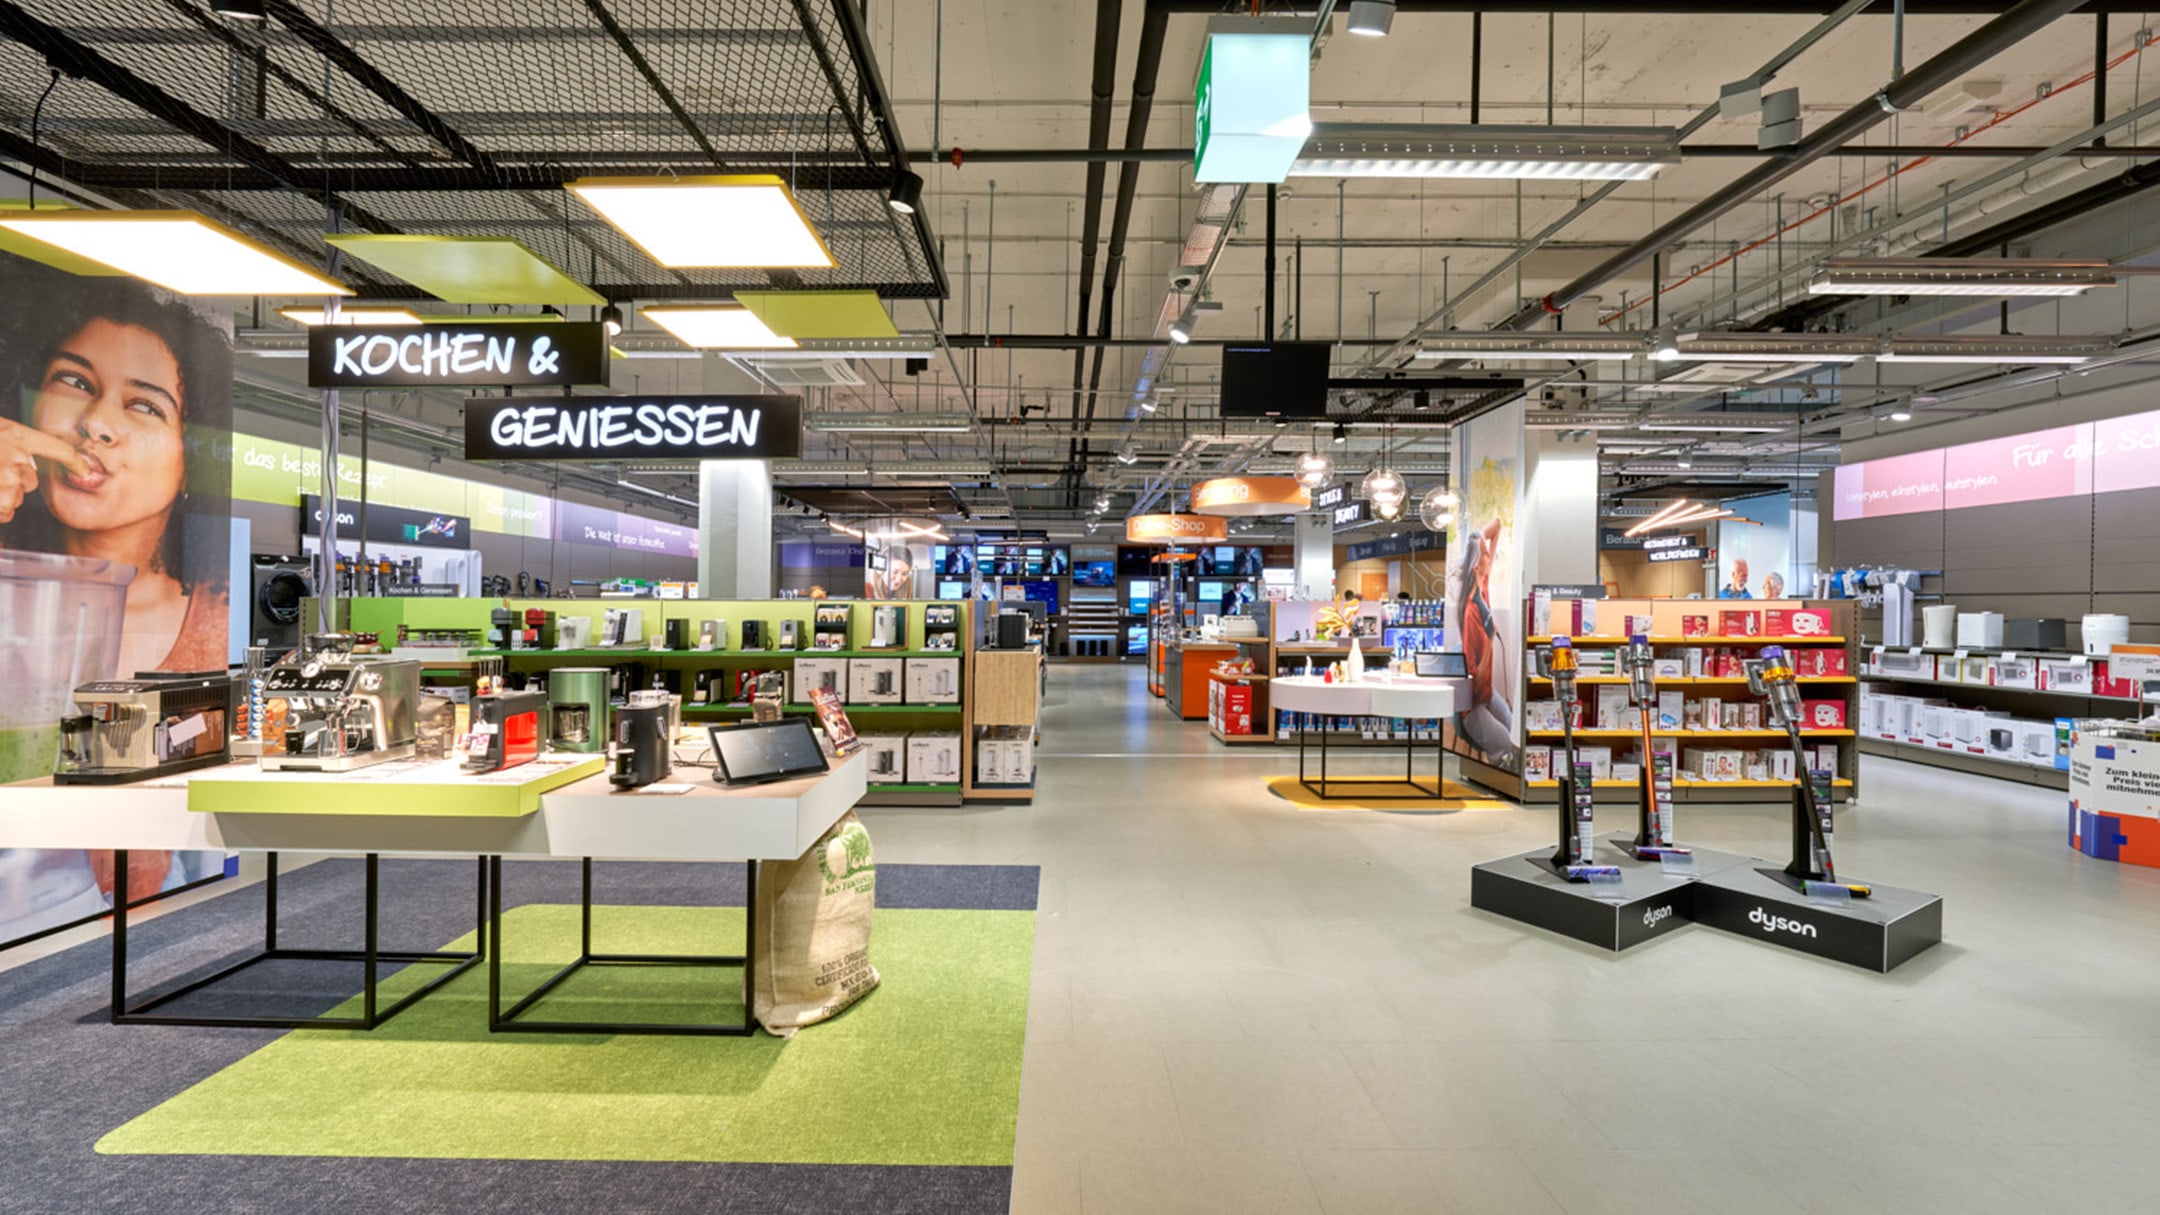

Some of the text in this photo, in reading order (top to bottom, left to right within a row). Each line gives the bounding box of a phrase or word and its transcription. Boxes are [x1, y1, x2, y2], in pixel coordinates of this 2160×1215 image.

[333, 332, 559, 377] KOCHEN &
[491, 405, 760, 448] GENIESSEN
[244, 447, 275, 471] das
[2012, 440, 2054, 468] Für
[2063, 438, 2108, 461] alle
[2105, 766, 2129, 776] Zum
[2112, 776, 2141, 787] Preis
[1643, 904, 1672, 928] dyson
[1748, 906, 1817, 938] dyson
